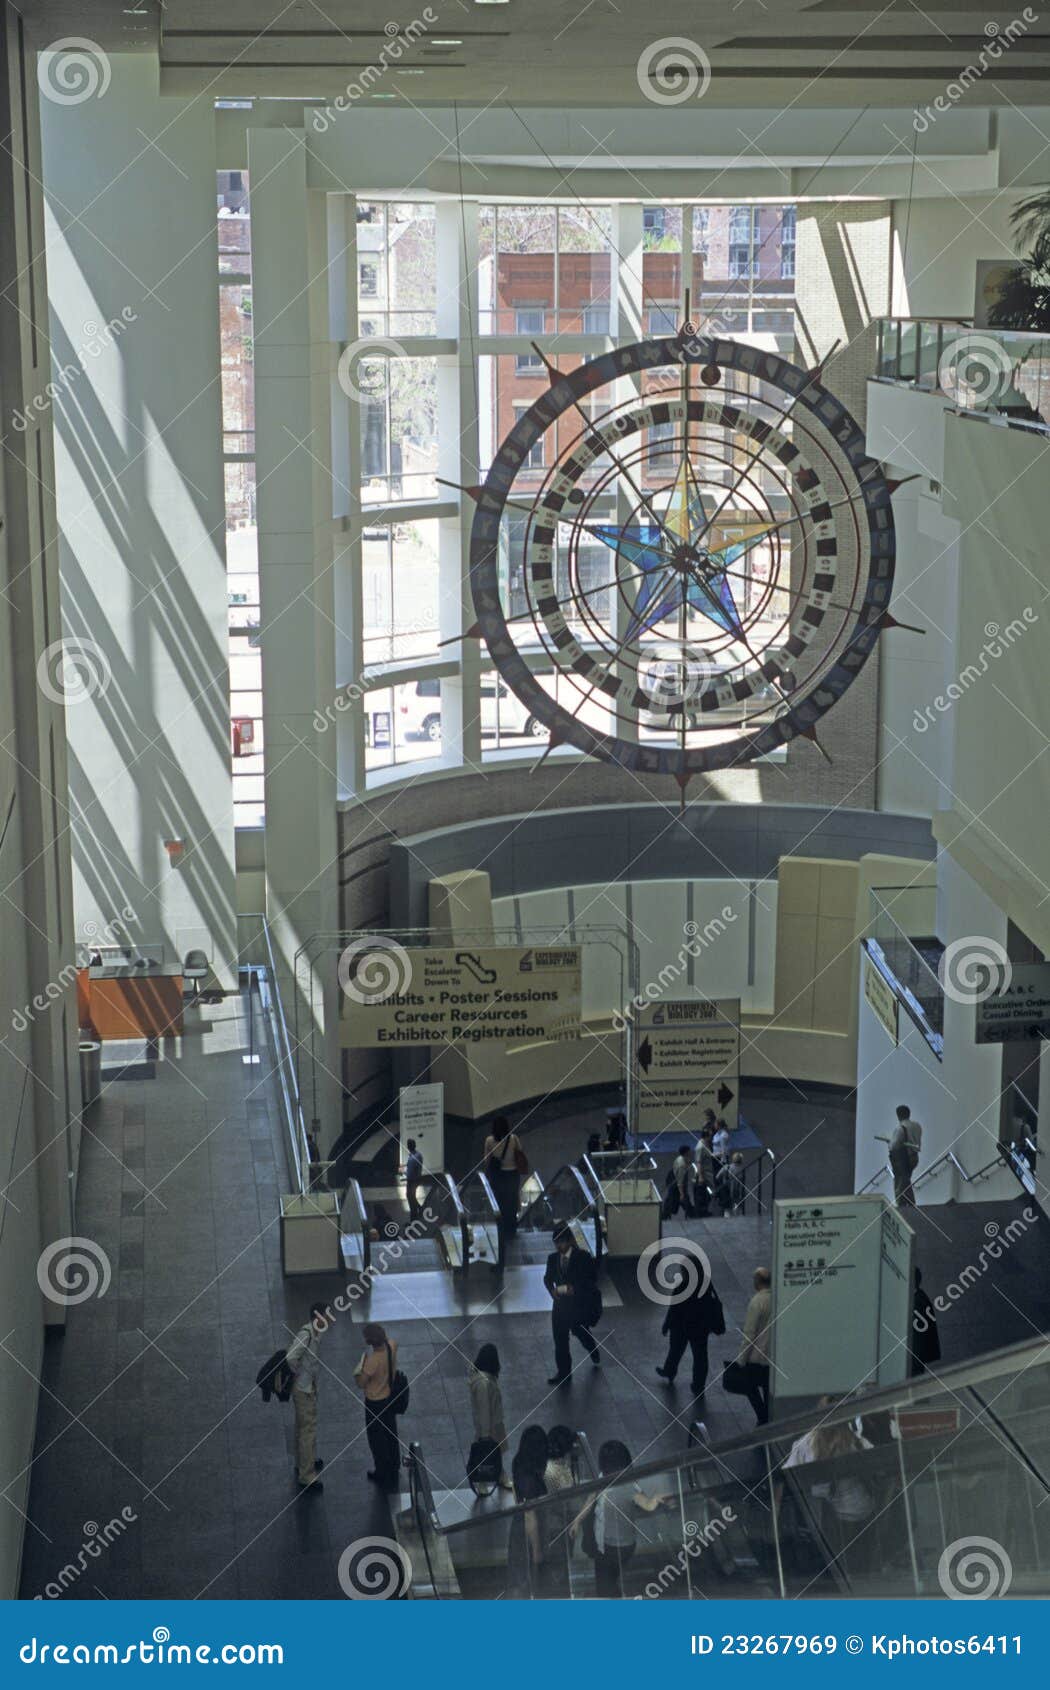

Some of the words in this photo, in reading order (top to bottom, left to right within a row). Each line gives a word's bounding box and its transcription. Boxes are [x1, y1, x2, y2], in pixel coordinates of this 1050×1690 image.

[424, 957, 443, 965] Take
[424, 967, 462, 976] Escalator
[424, 978, 449, 986] Down
[451, 977, 461, 985] To
[440, 990, 490, 1004] Poster
[494, 988, 558, 1001] Sessions
[394, 1010, 446, 1023] Career
[451, 1008, 528, 1021] Resources
[1013, 1009, 1043, 1018] Dining
[377, 1028, 447, 1041] Exhibitor
[452, 1025, 545, 1041] Registration
[808, 1239, 832, 1247] Dining
